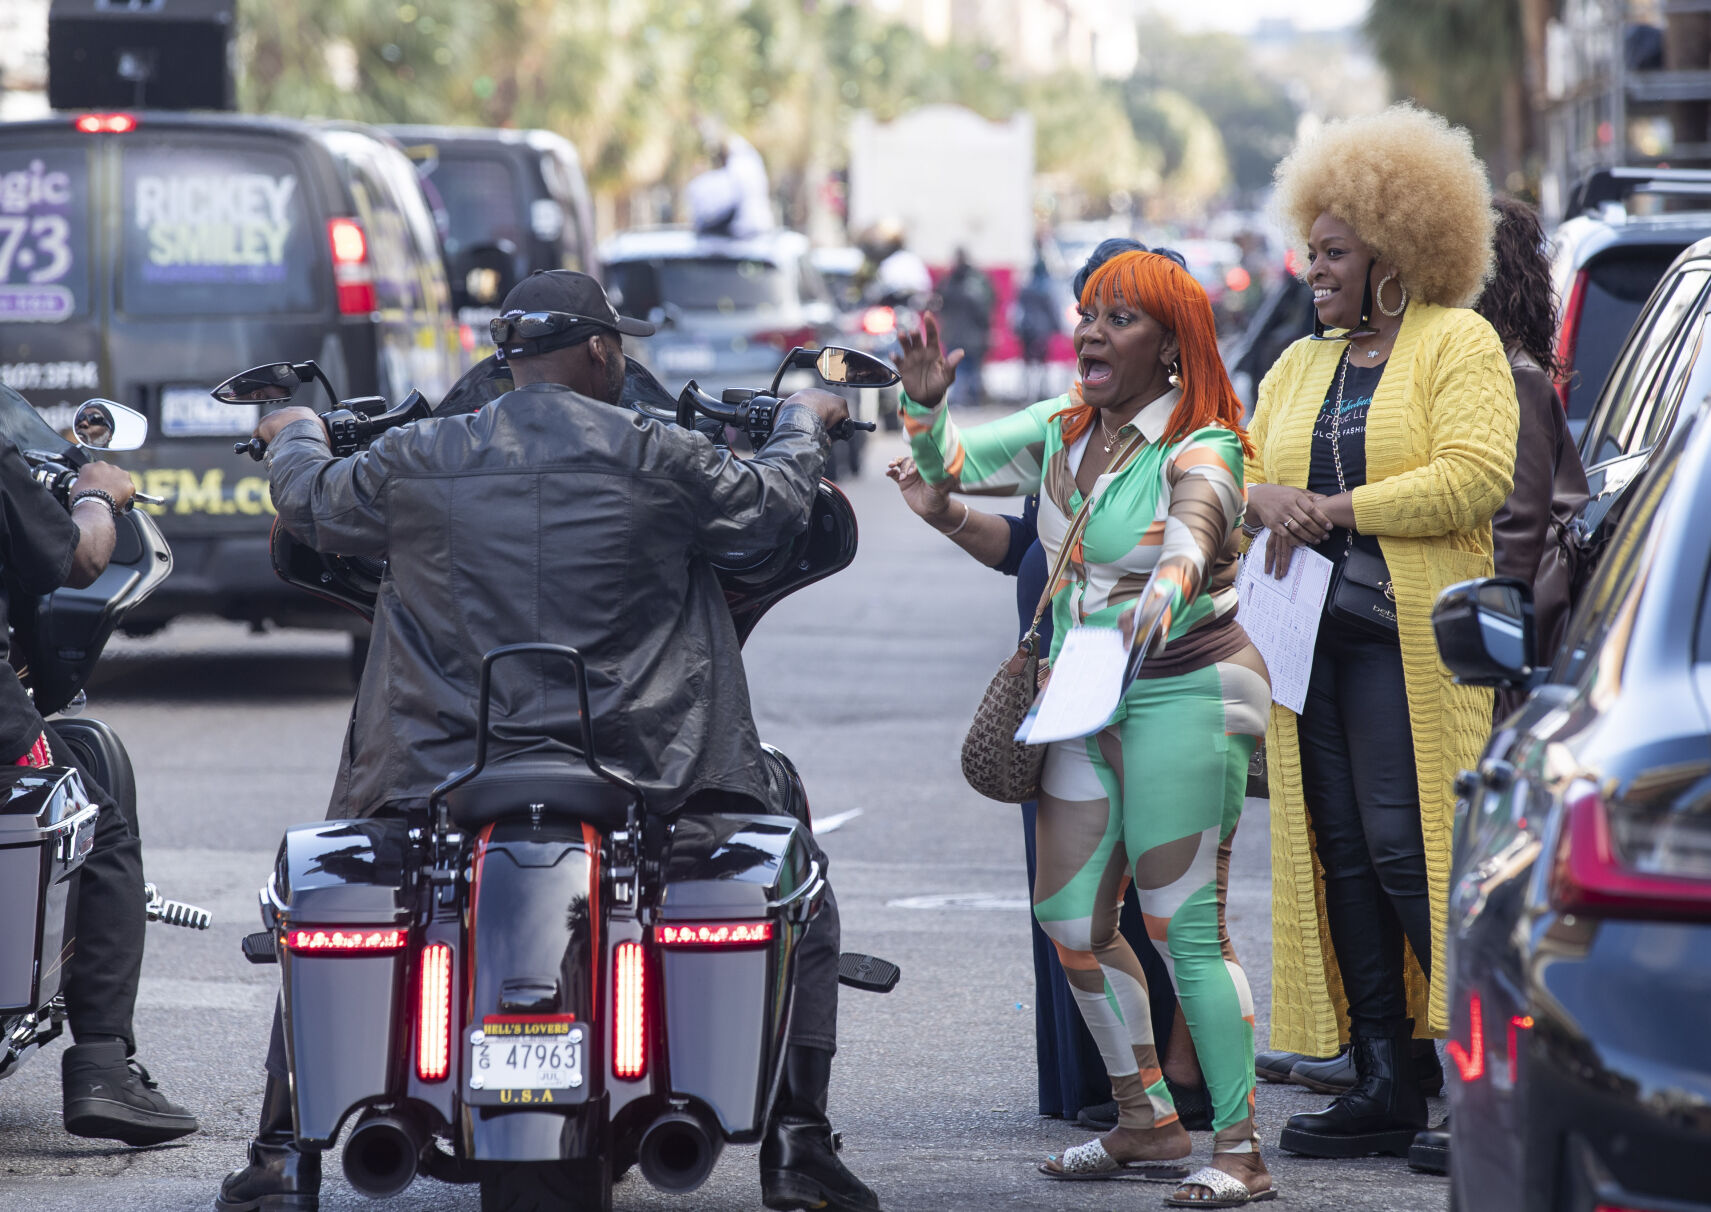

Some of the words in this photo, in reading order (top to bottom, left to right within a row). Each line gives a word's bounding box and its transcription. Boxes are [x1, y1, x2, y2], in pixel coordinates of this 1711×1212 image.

[137, 175, 295, 227] RICKEY
[150, 221, 290, 266] SMILEY
[483, 1024, 522, 1034] HELL'S
[524, 1023, 569, 1034] LOVERS
[506, 1044, 576, 1069] 47963
